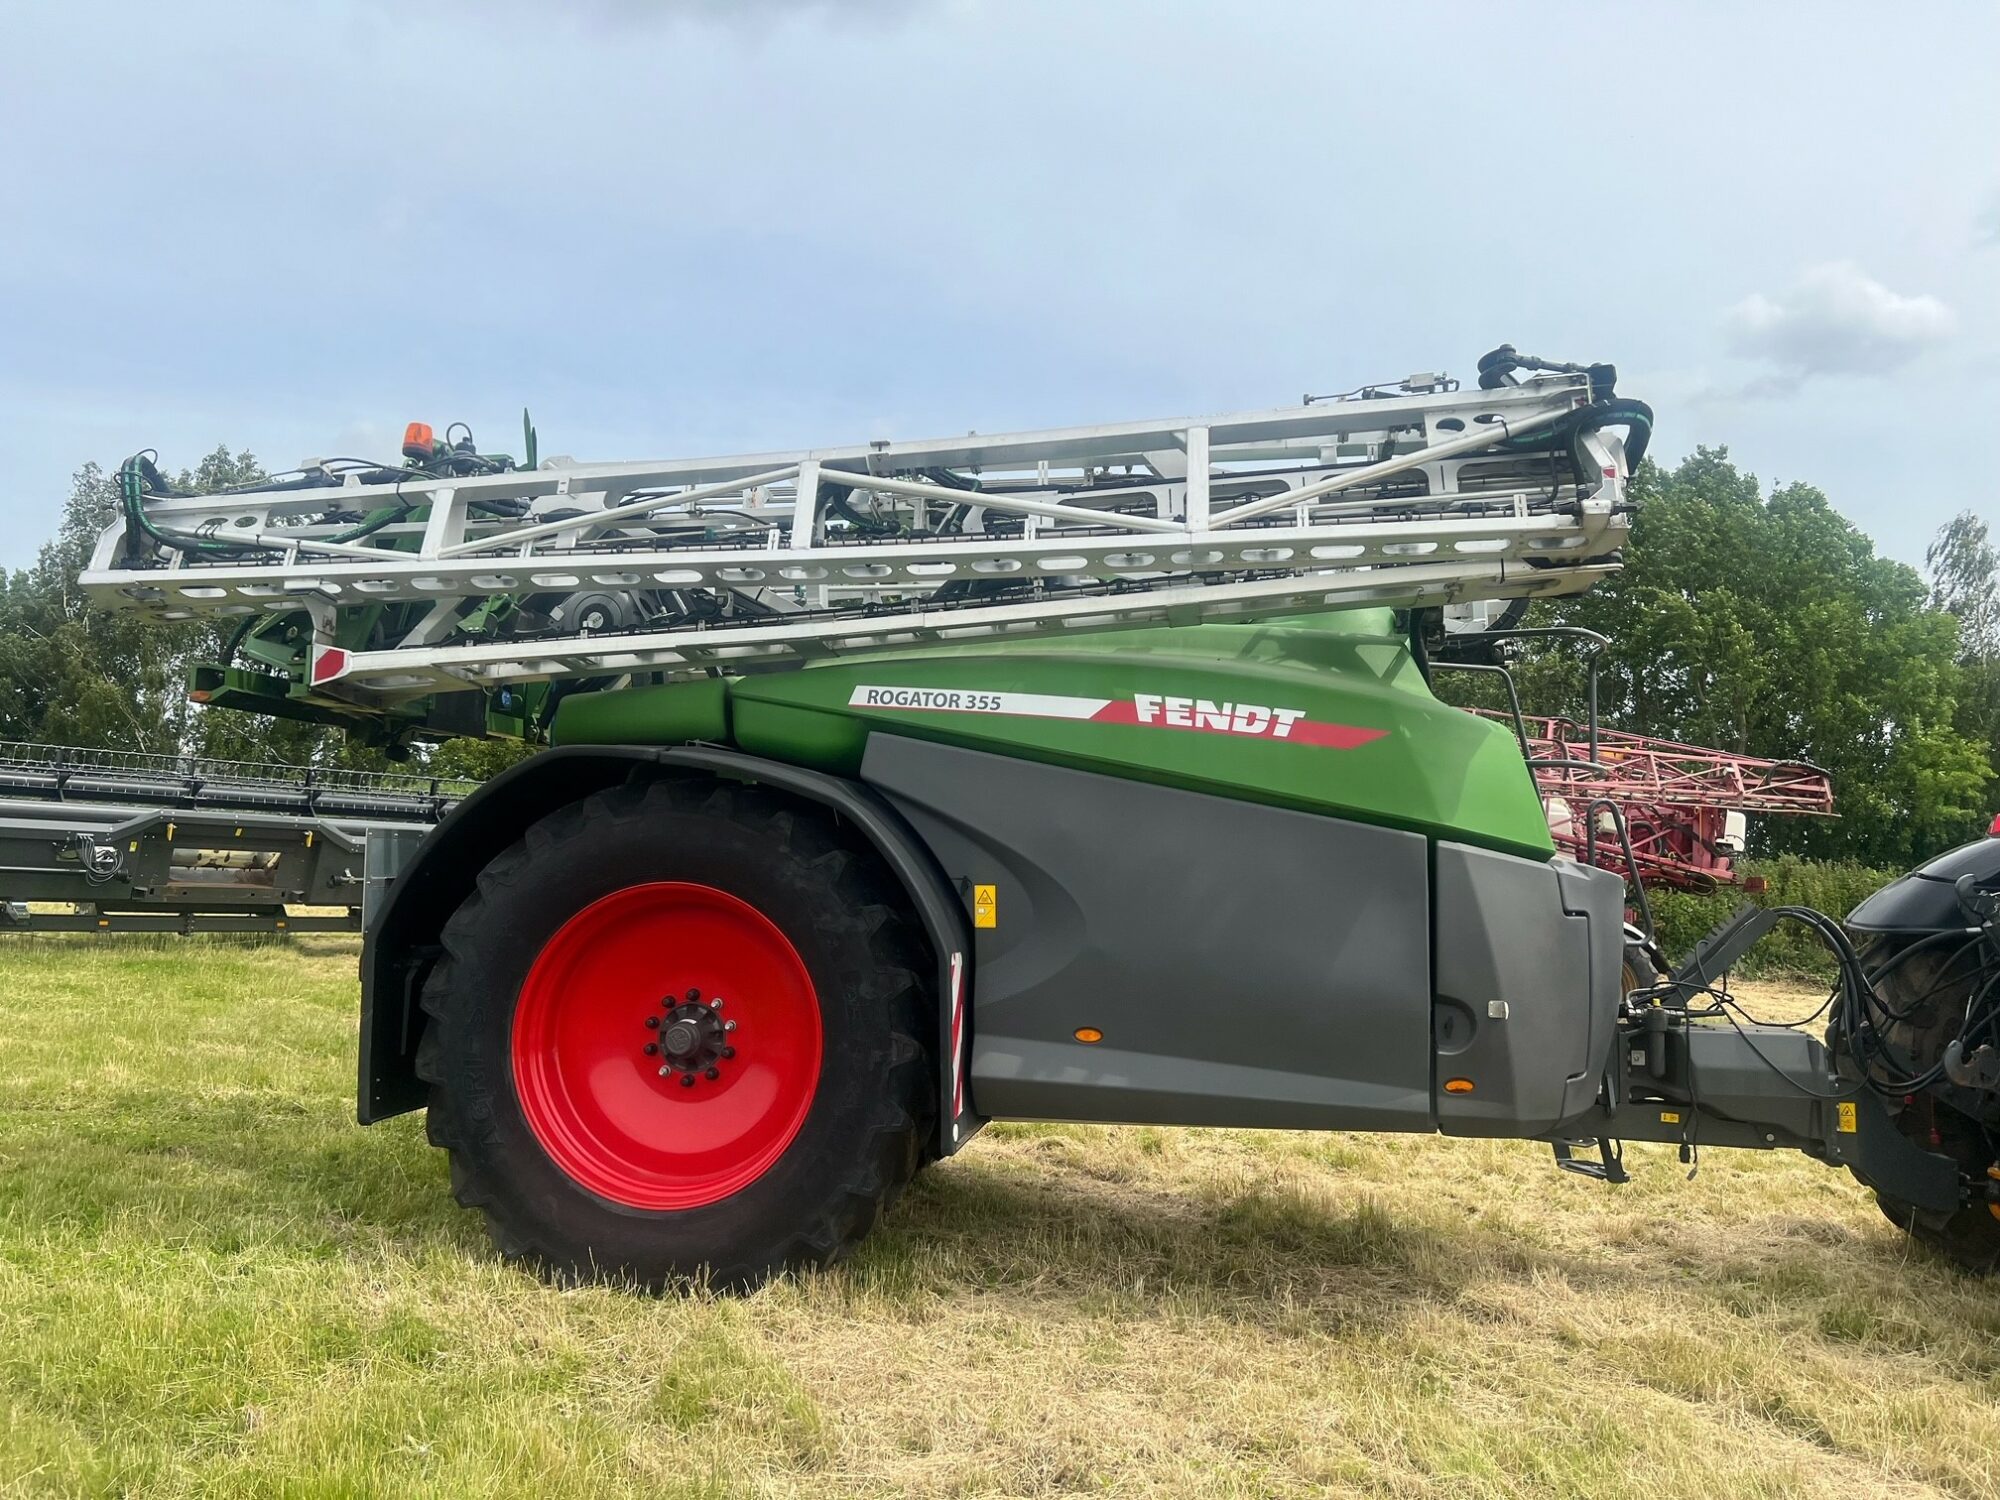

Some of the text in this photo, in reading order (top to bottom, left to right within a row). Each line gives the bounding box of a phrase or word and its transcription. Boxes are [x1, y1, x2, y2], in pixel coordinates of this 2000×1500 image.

[867, 689, 1001, 711] ROGATOR 355
[1134, 693, 1306, 737] FENDT
